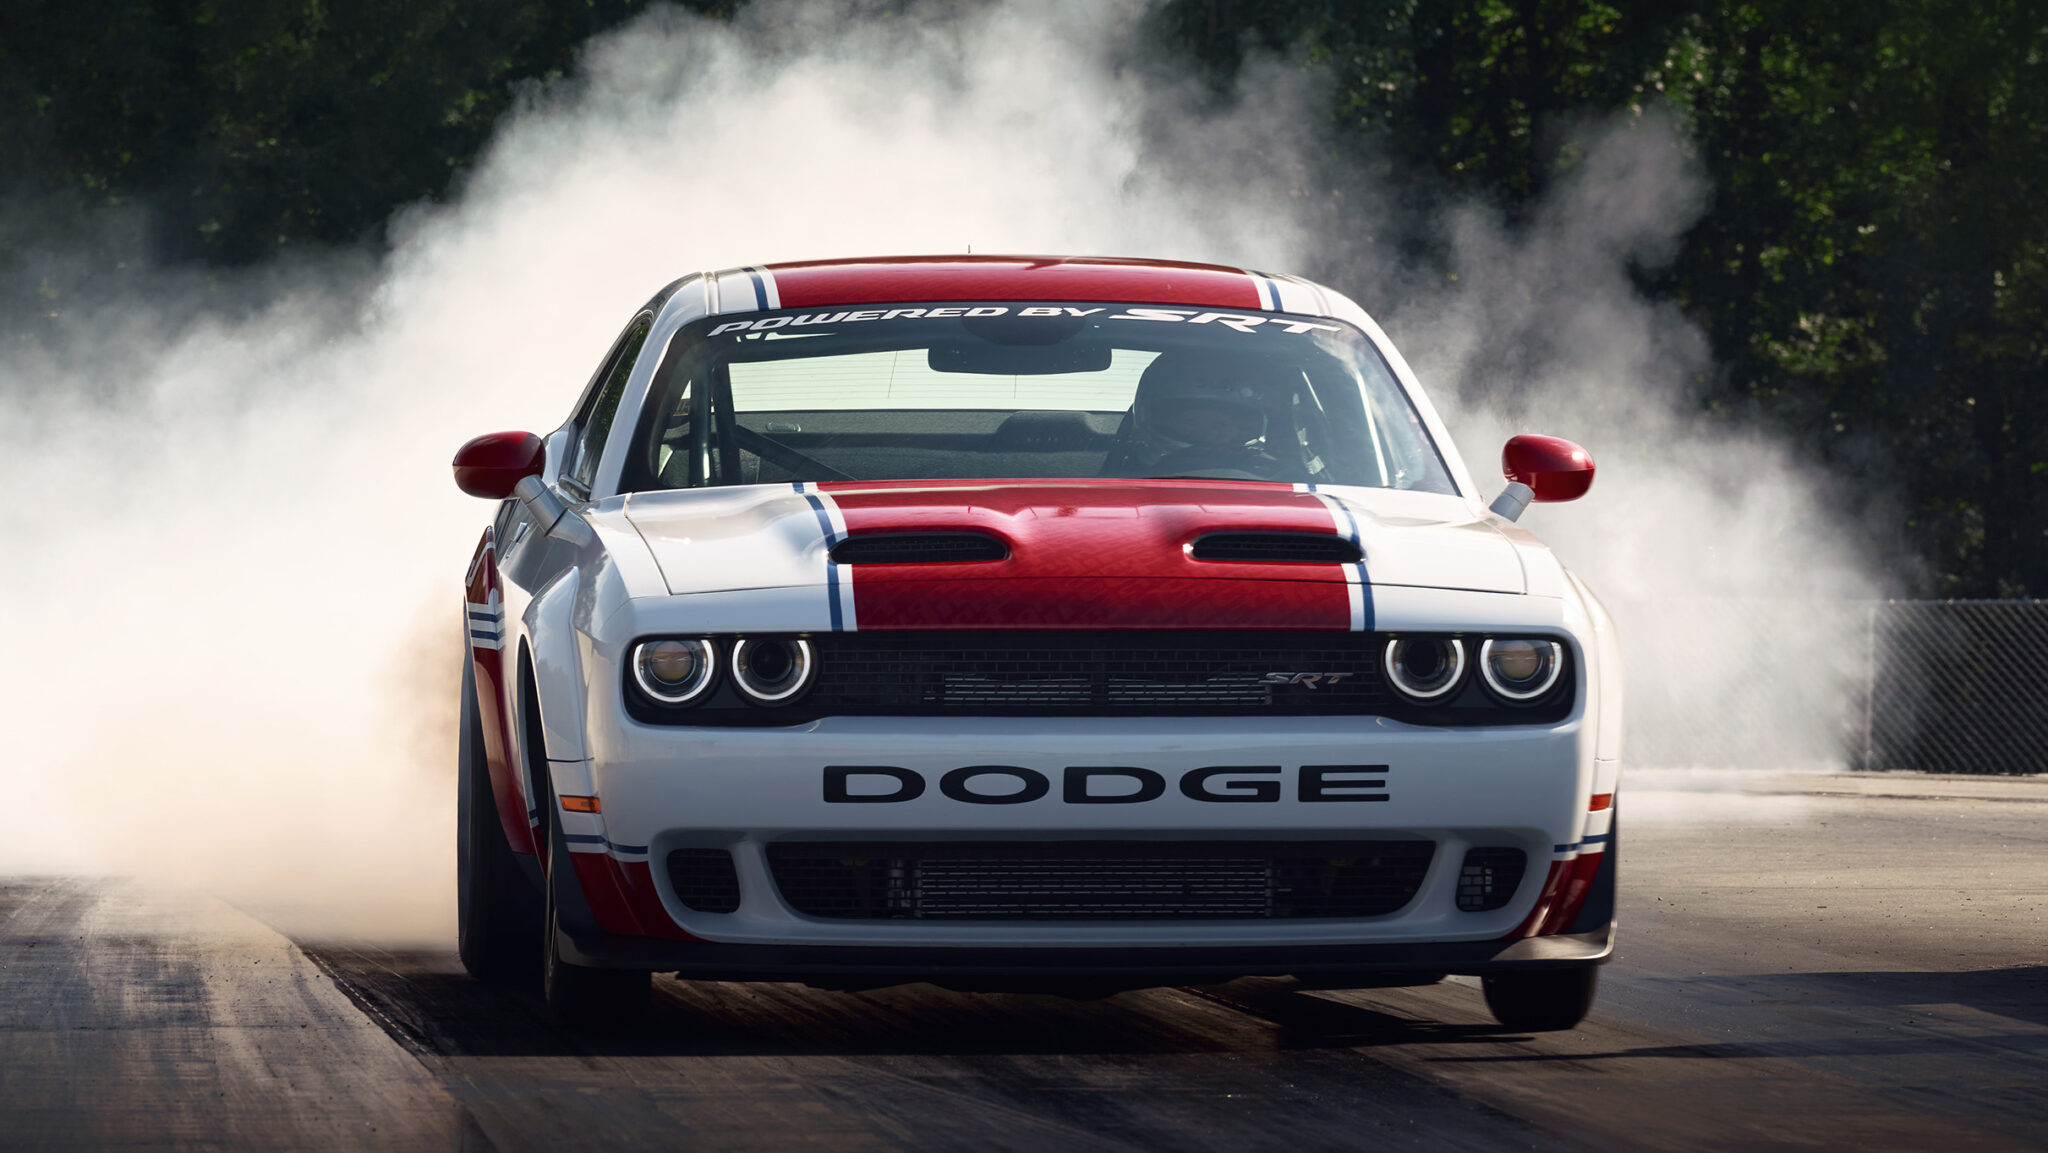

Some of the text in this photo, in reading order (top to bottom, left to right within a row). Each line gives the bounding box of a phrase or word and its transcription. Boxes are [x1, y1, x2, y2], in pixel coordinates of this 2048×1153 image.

[707, 307, 1342, 337] POWERED BY SRT
[1258, 672, 1354, 690] SRT
[823, 765, 1390, 804] DODGE
